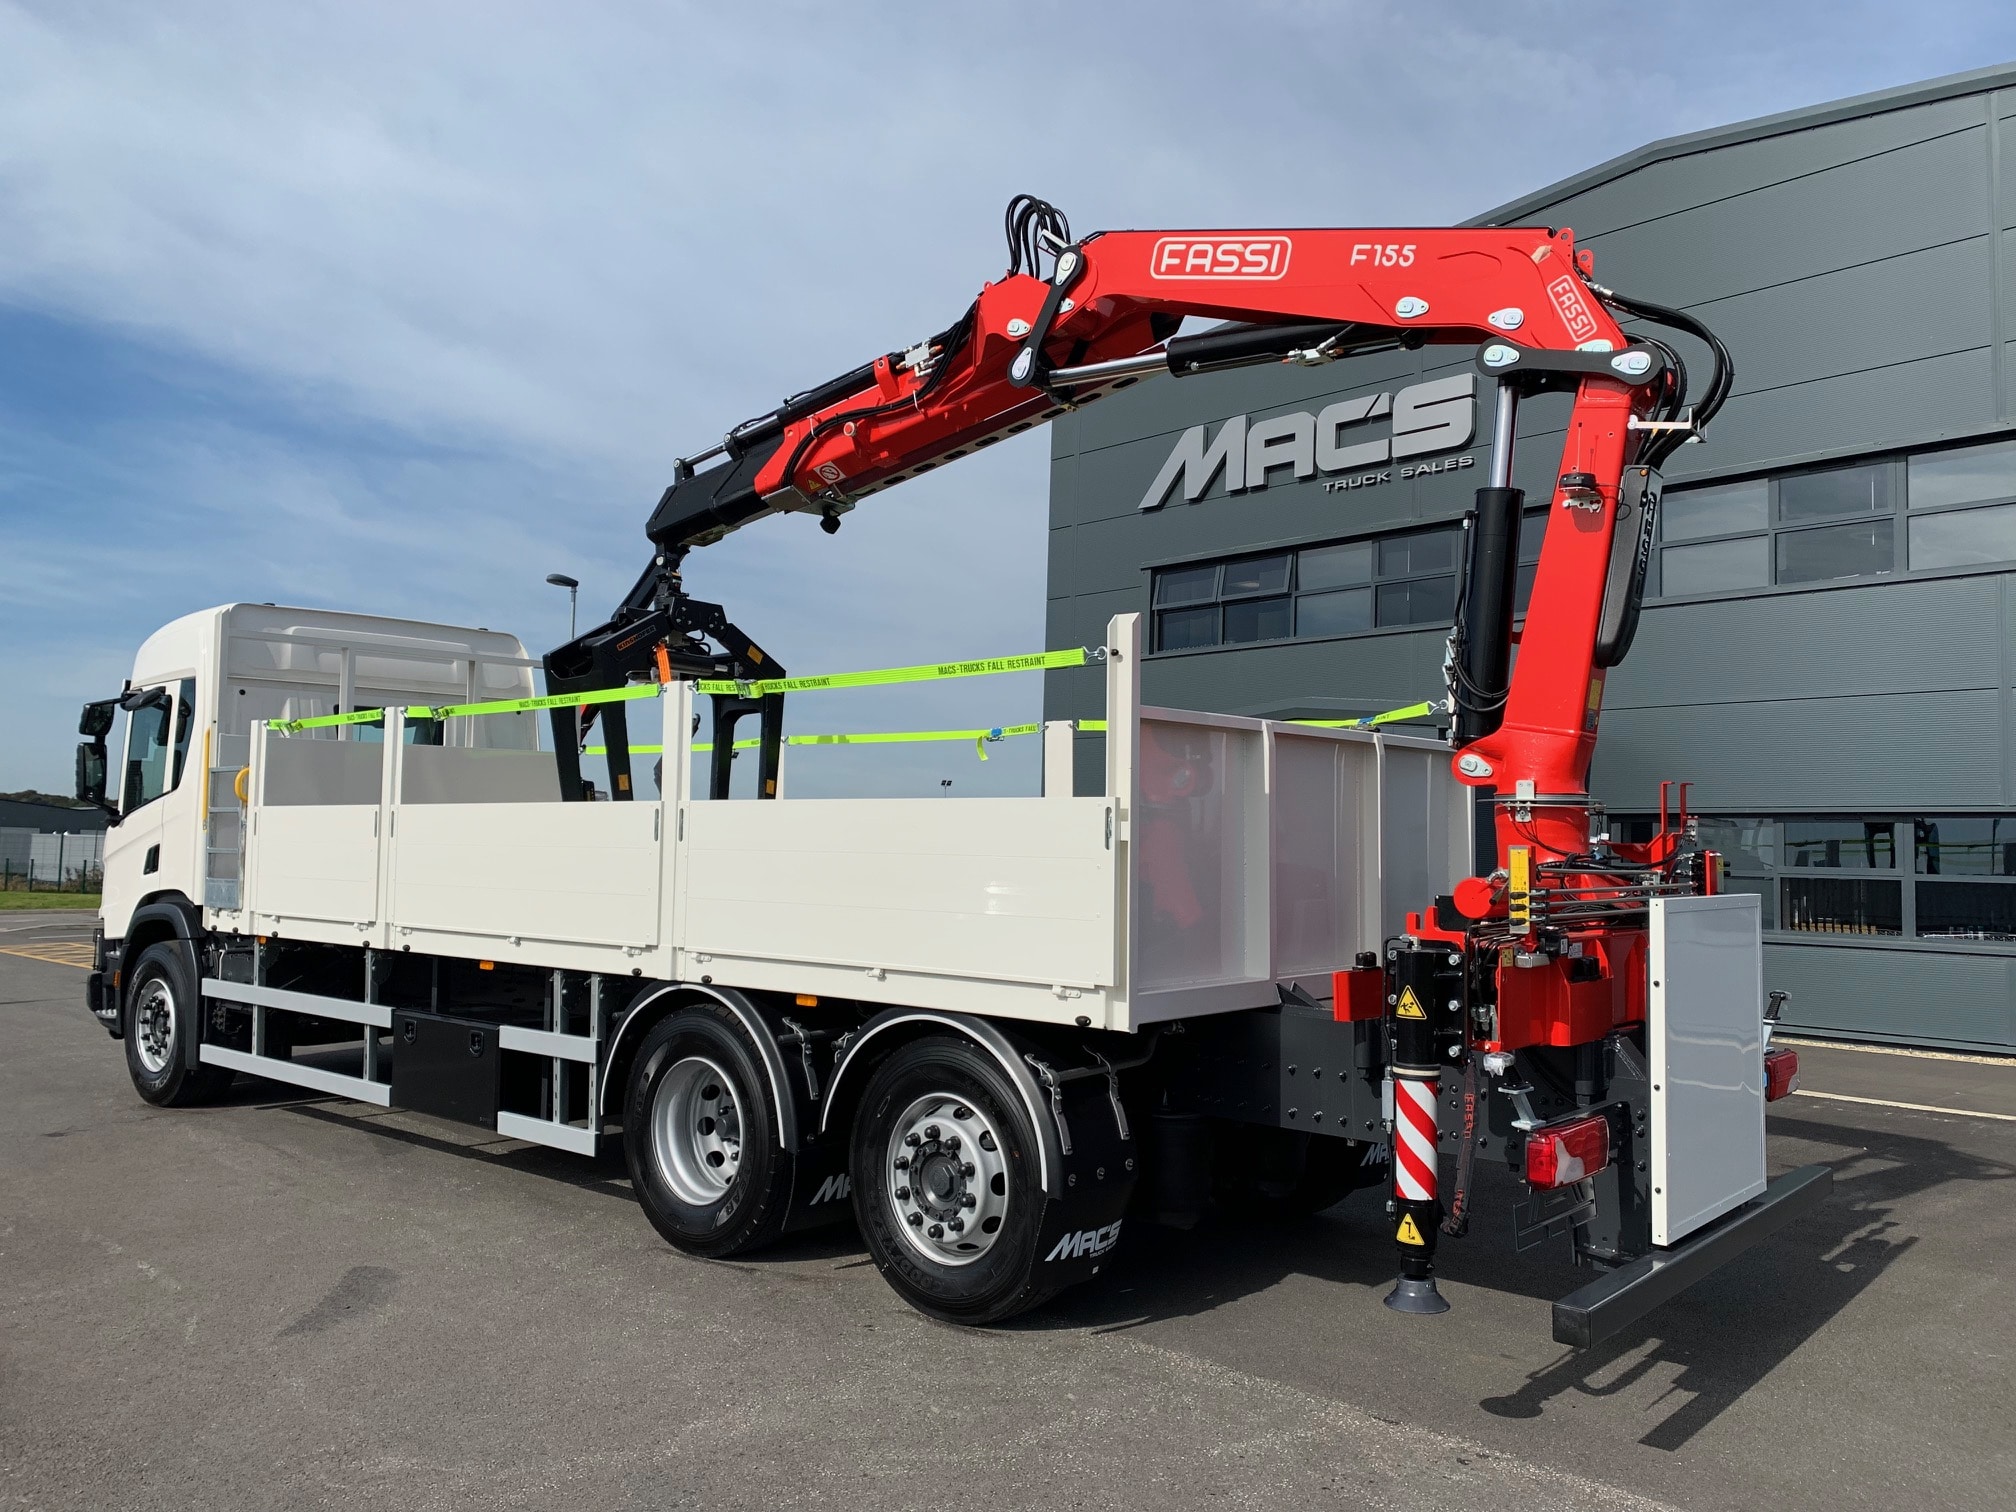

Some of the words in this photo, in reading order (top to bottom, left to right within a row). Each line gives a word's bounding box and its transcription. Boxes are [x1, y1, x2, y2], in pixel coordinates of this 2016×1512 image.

[1160, 243, 1281, 273] FASSI
[1350, 244, 1417, 268] F155
[1553, 281, 1591, 335] FASSI
[1322, 471, 1391, 493] TRUCK
[1400, 455, 1475, 479] SALES
[938, 664, 985, 676] MACS-TRUCKS
[987, 661, 1005, 671] FALL
[1007, 656, 1046, 669] RESTRAINT
[783, 680, 798, 690] FALL
[799, 677, 831, 689] RESTRAINT
